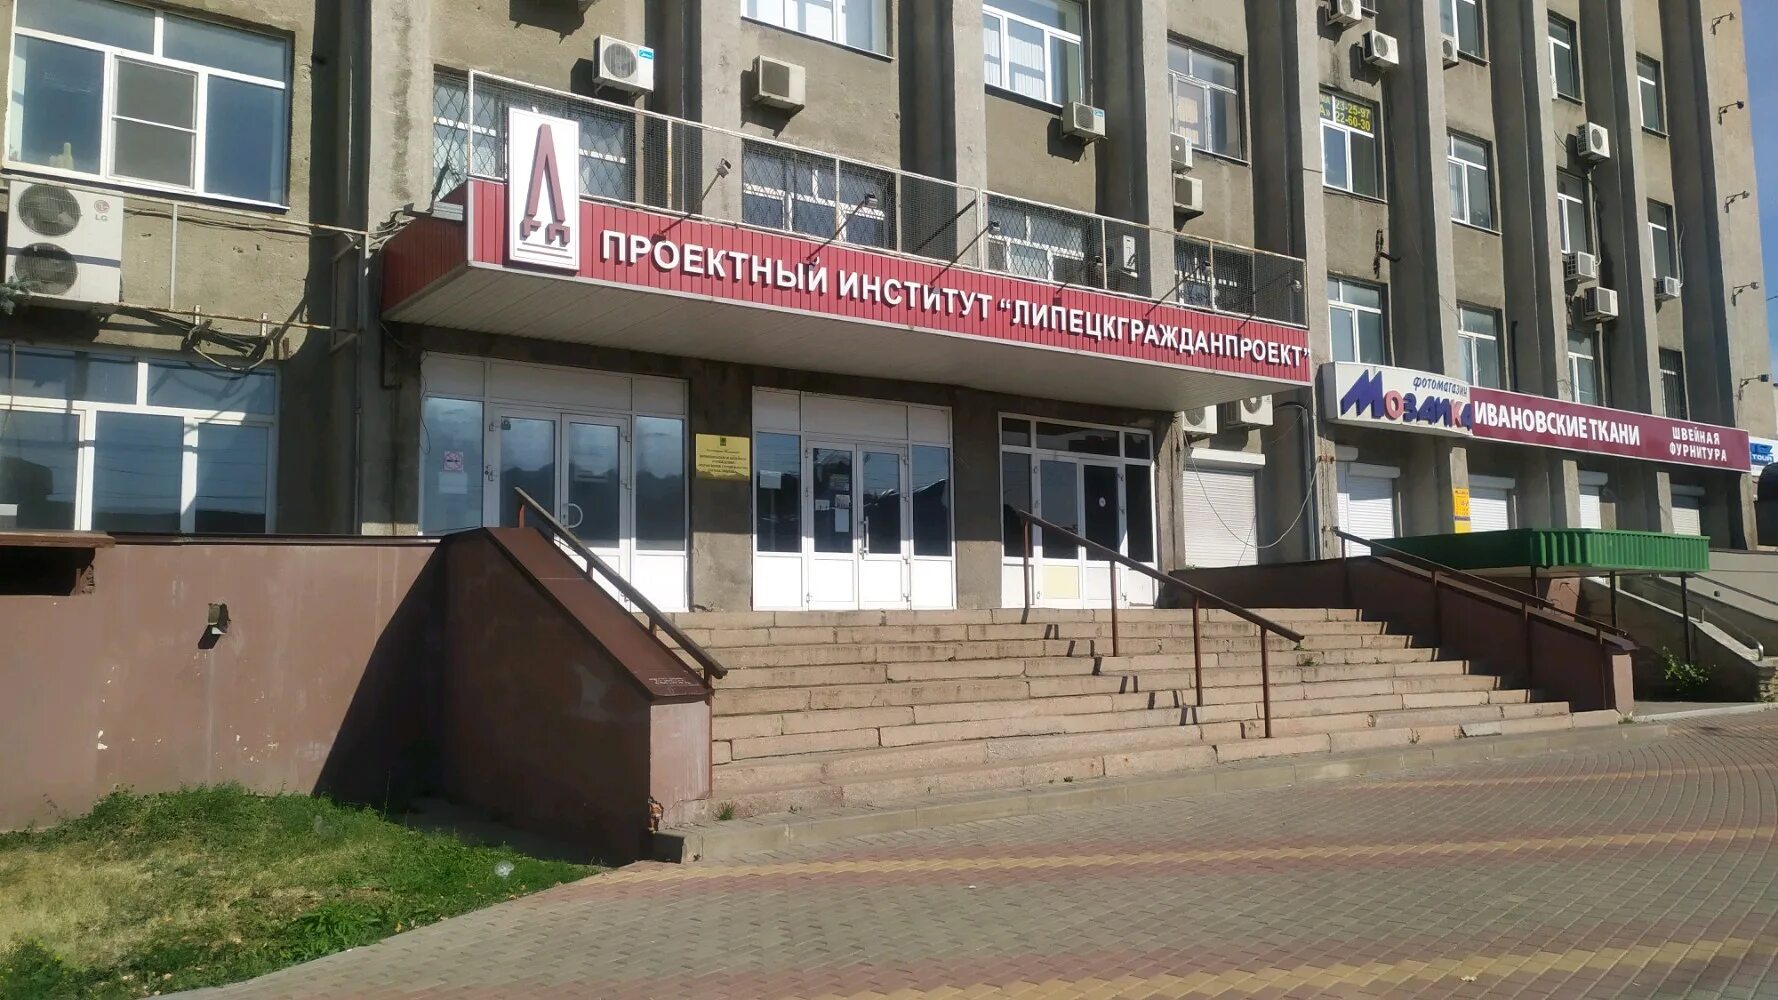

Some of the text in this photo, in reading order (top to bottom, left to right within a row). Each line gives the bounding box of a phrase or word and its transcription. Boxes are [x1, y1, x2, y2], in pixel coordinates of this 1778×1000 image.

[1335, 99, 1371, 119] 23-25-97
[1335, 110, 1371, 131] 22-60-30
[602, 229, 828, 294] ПРОЕКТНЫЙ
[838, 269, 992, 319] ИНСТИТУТ
[1474, 400, 1641, 446] ИВАНОВСКИЕ ТКАНИ
[1672, 426, 1720, 446] ШВЕЙНАЯ
[1669, 441, 1727, 462] ФУРНИТУРА
